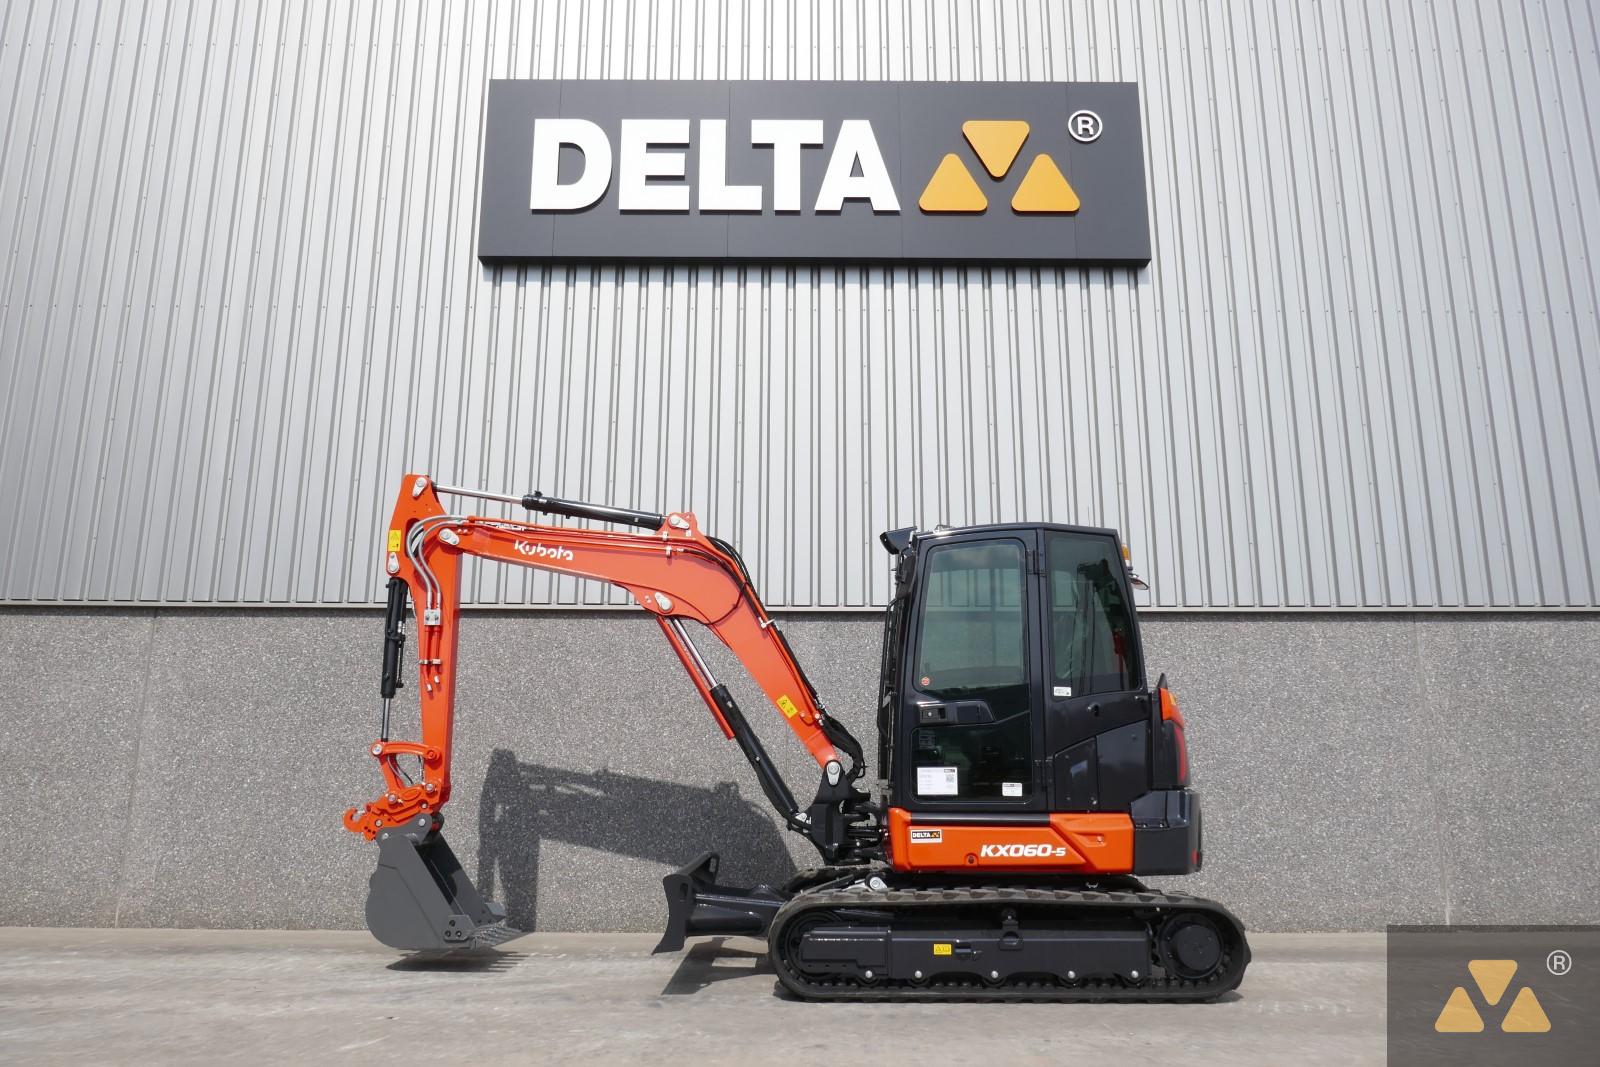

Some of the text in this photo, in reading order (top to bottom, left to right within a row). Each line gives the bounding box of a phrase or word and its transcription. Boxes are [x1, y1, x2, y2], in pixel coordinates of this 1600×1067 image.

[530, 118, 901, 211] DELTA
[515, 540, 574, 560] Kubota
[981, 844, 1066, 857] KX060-5
